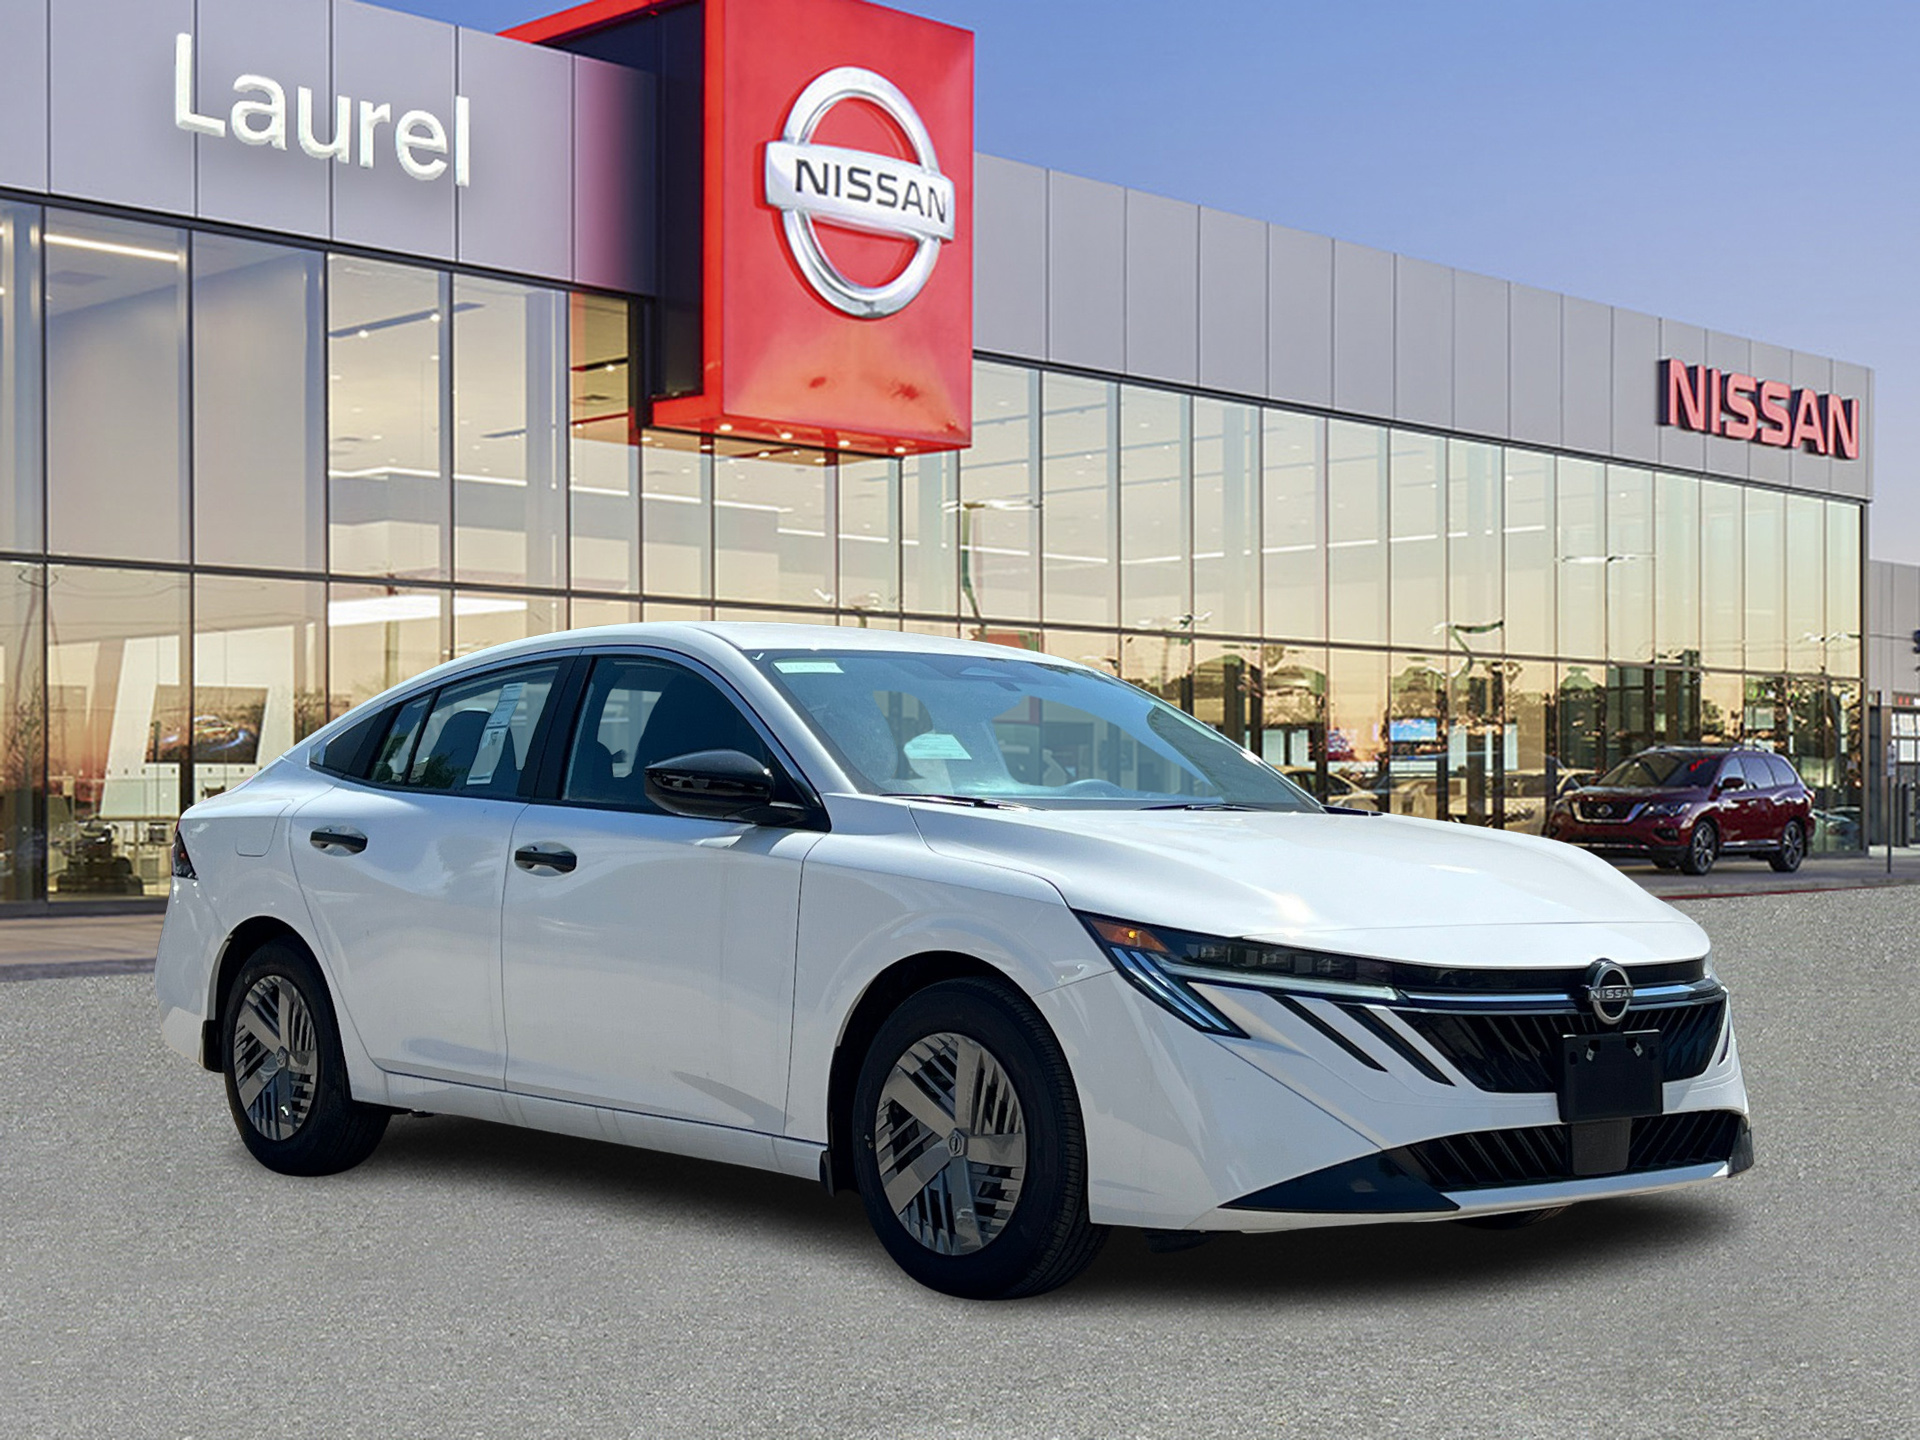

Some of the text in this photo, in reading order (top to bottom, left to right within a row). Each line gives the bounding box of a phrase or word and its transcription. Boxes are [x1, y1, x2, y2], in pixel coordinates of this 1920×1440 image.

[175, 32, 470, 188] Laurel
[795, 158, 947, 224] NISSAN
[1658, 358, 1860, 460] NISSAN
[1590, 988, 1632, 999] NISSAN
